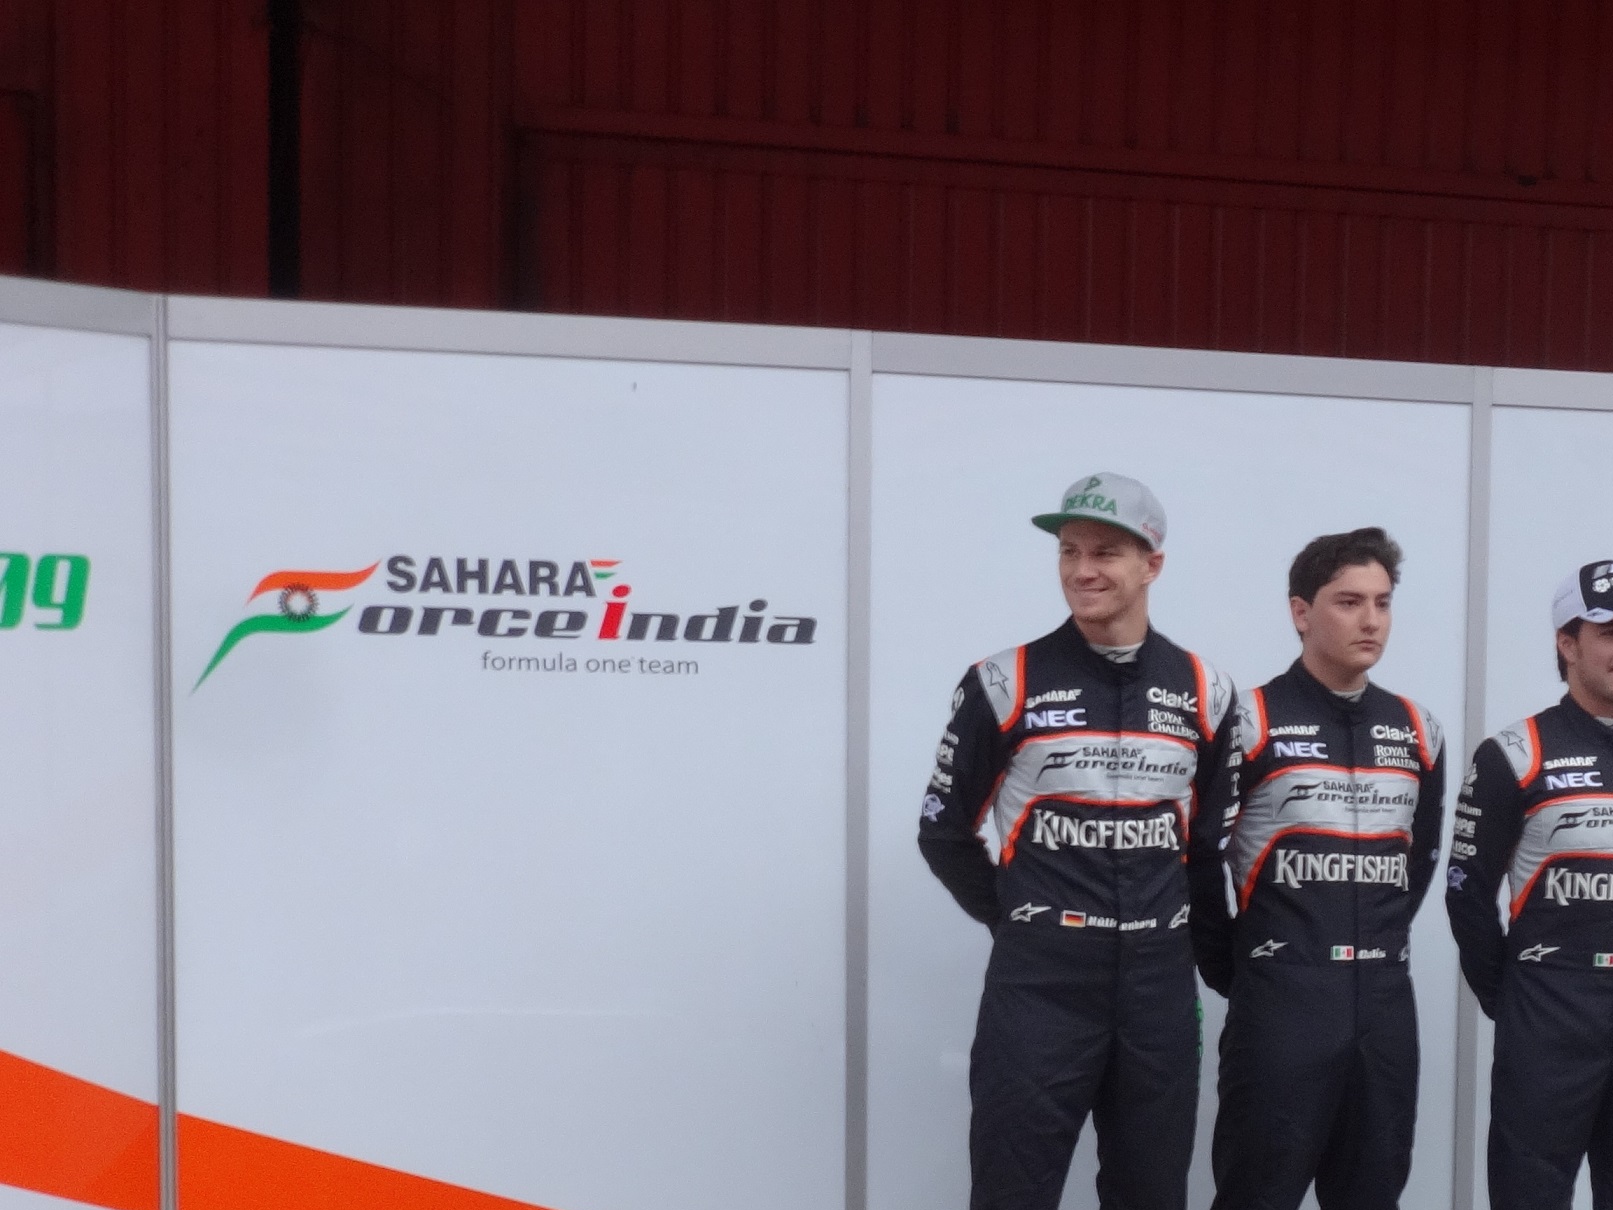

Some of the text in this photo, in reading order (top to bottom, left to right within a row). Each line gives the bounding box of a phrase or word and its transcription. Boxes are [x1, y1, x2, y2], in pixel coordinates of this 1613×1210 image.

[385, 555, 598, 598] SAHARA
[481, 650, 699, 675] formula one team
[1024, 688, 1079, 709] SAHARA
[1024, 708, 1087, 730] NEC
[1268, 724, 1318, 737] SAHARA
[1082, 746, 1138, 758] SAHARA
[1273, 741, 1329, 759] NEC
[1374, 744, 1411, 758] ROYAL
[1543, 755, 1595, 770] SAHARA
[1323, 780, 1371, 794] SAHARA
[1545, 771, 1604, 791] NEC
[1031, 807, 1180, 851] KINGFISHER
[1272, 849, 1409, 892] KINGFISHER
